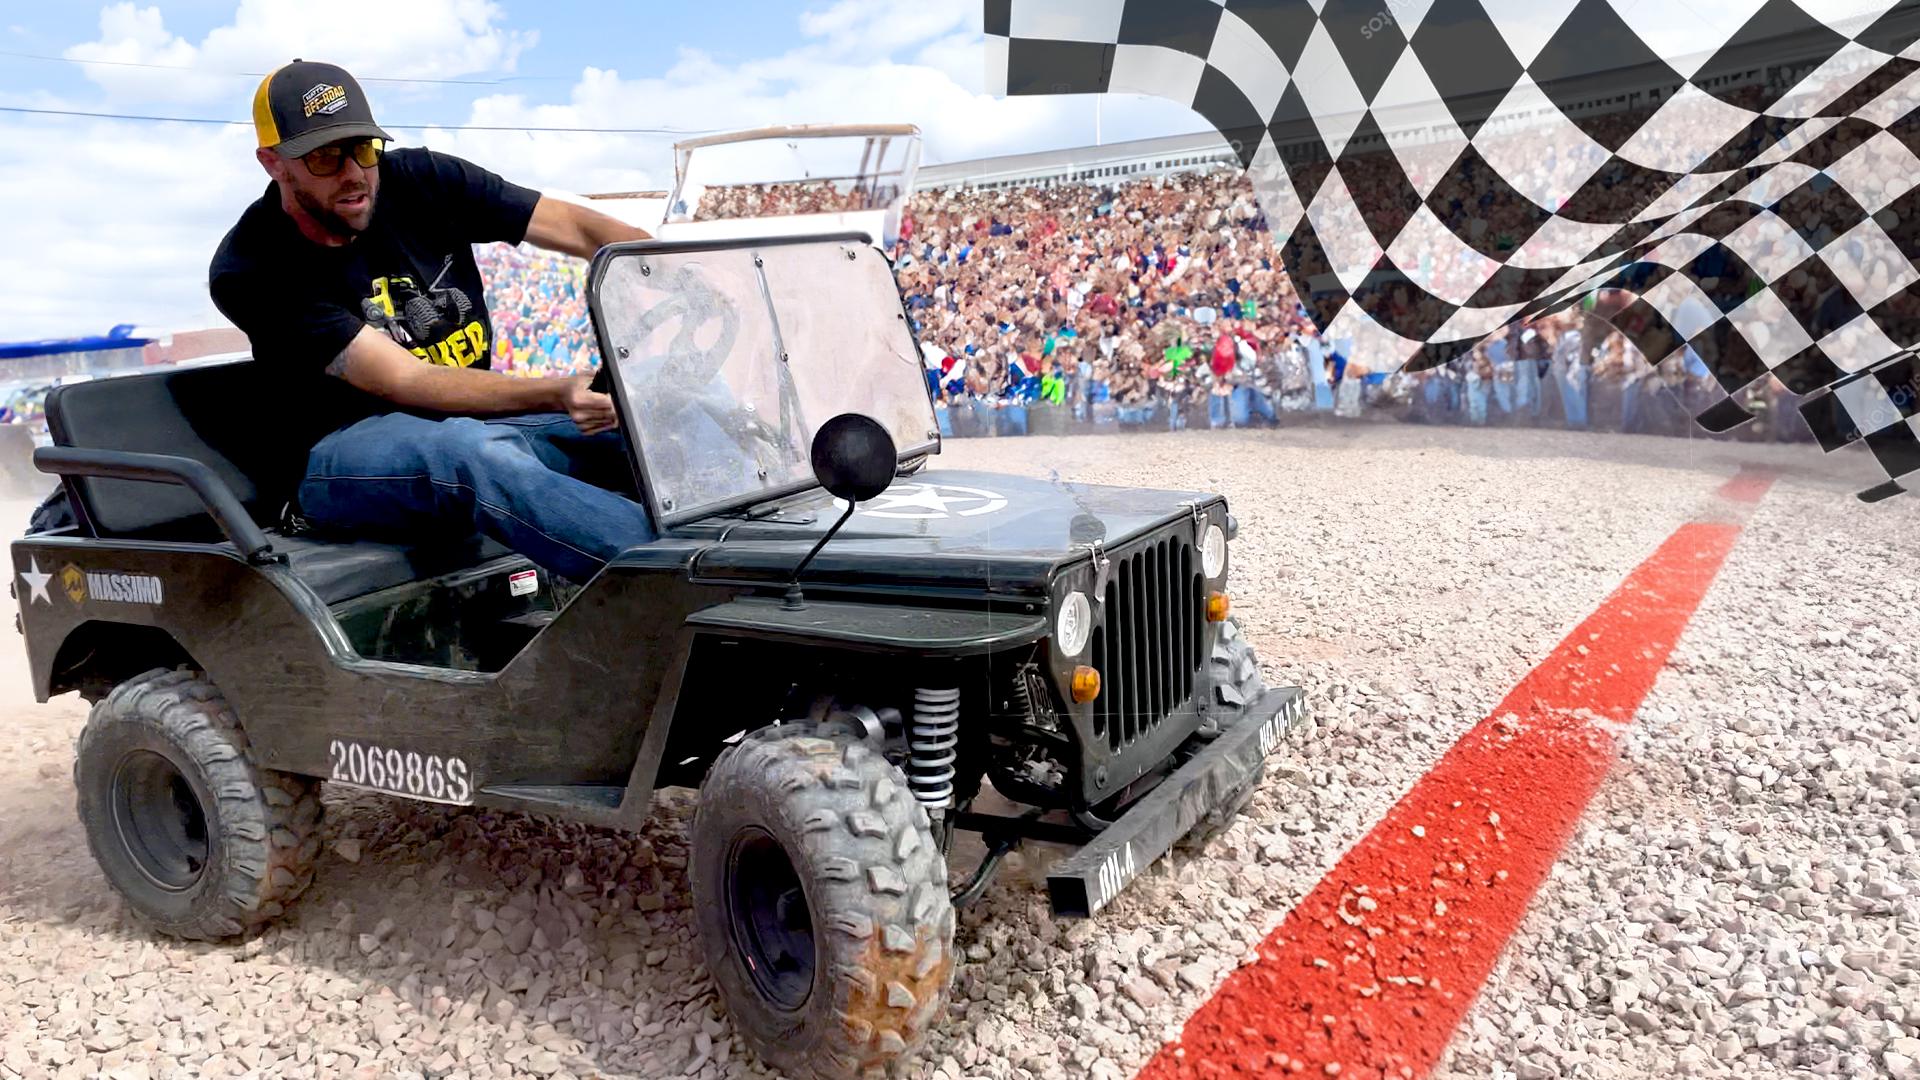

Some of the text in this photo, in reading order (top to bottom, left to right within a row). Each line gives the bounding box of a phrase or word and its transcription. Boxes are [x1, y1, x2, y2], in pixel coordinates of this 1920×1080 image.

[303, 85, 345, 118] OFF-ROAD
[86, 572, 163, 605] MASSIMO
[329, 739, 469, 802] 206986S
